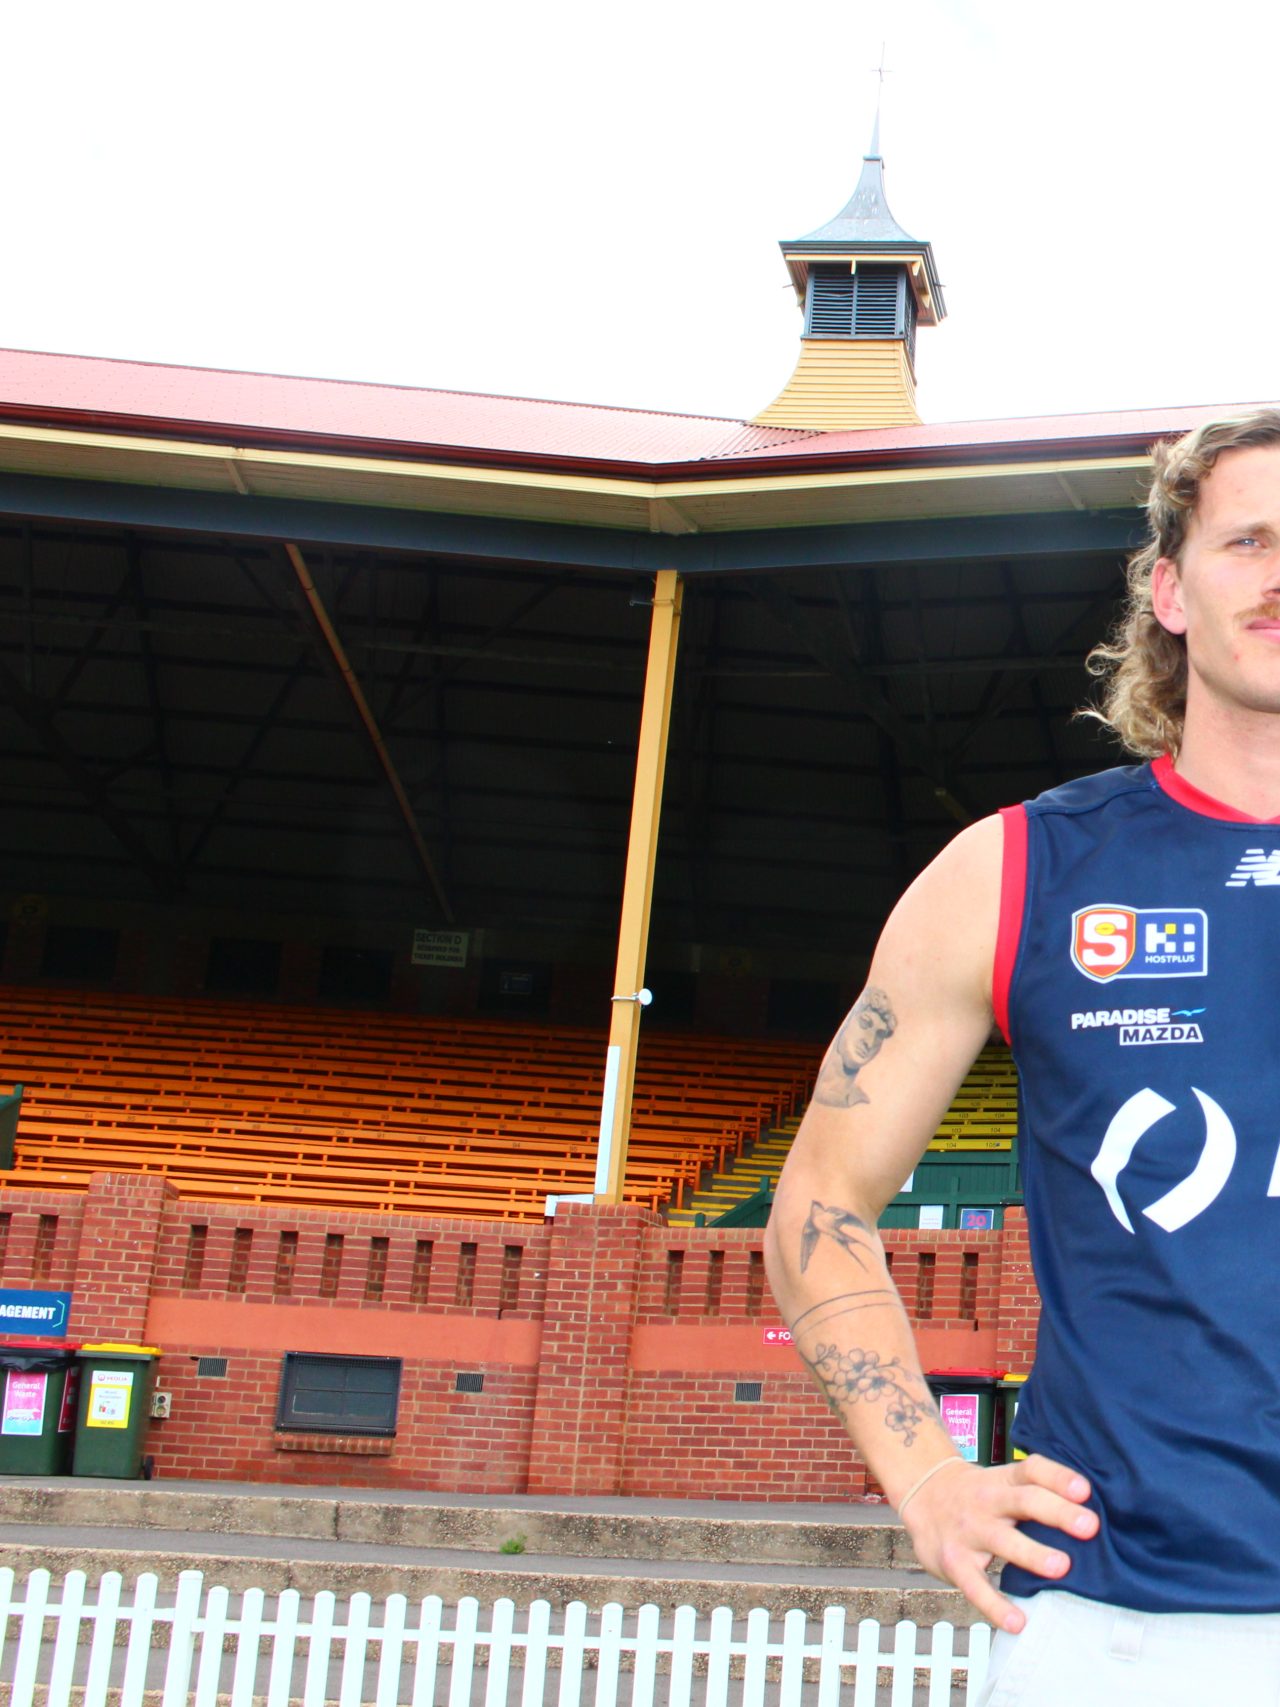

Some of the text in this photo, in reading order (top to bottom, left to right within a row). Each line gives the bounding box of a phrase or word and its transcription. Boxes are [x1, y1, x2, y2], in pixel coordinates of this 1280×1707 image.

[1083, 913, 1128, 965] S
[1145, 954, 1195, 963] HOSTPLUS
[1071, 1008, 1170, 1029] PARADISE
[1122, 1028, 1200, 1043] MAZDA
[967, 1215, 986, 1227] 20
[12, 1381, 41, 1390] General
[14, 1390, 36, 1398] Waste
[945, 1408, 972, 1416] General
[948, 1417, 969, 1425] Waste
